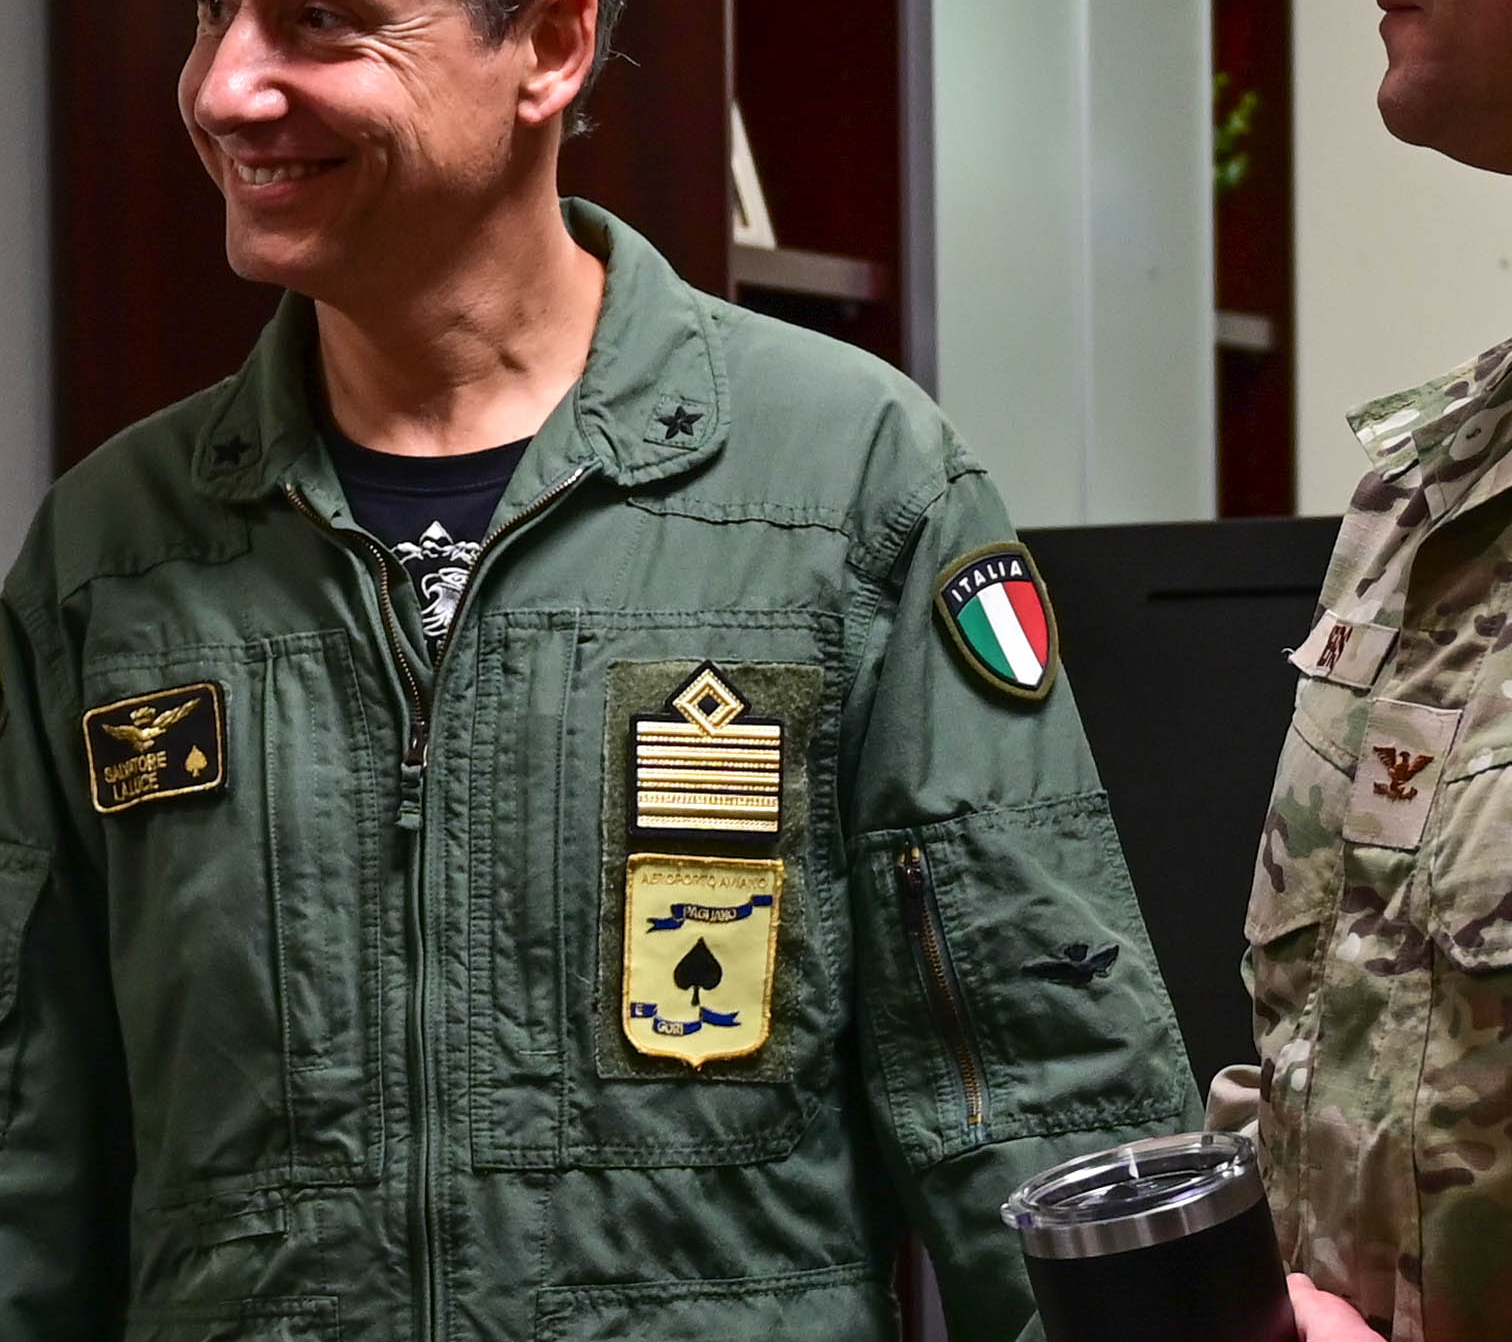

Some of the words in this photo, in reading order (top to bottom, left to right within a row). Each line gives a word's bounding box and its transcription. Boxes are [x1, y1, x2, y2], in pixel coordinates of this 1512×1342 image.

[951, 560, 1023, 602] ITALIA
[103, 750, 168, 784] SALVATORE
[657, 1021, 684, 1036] GORI
